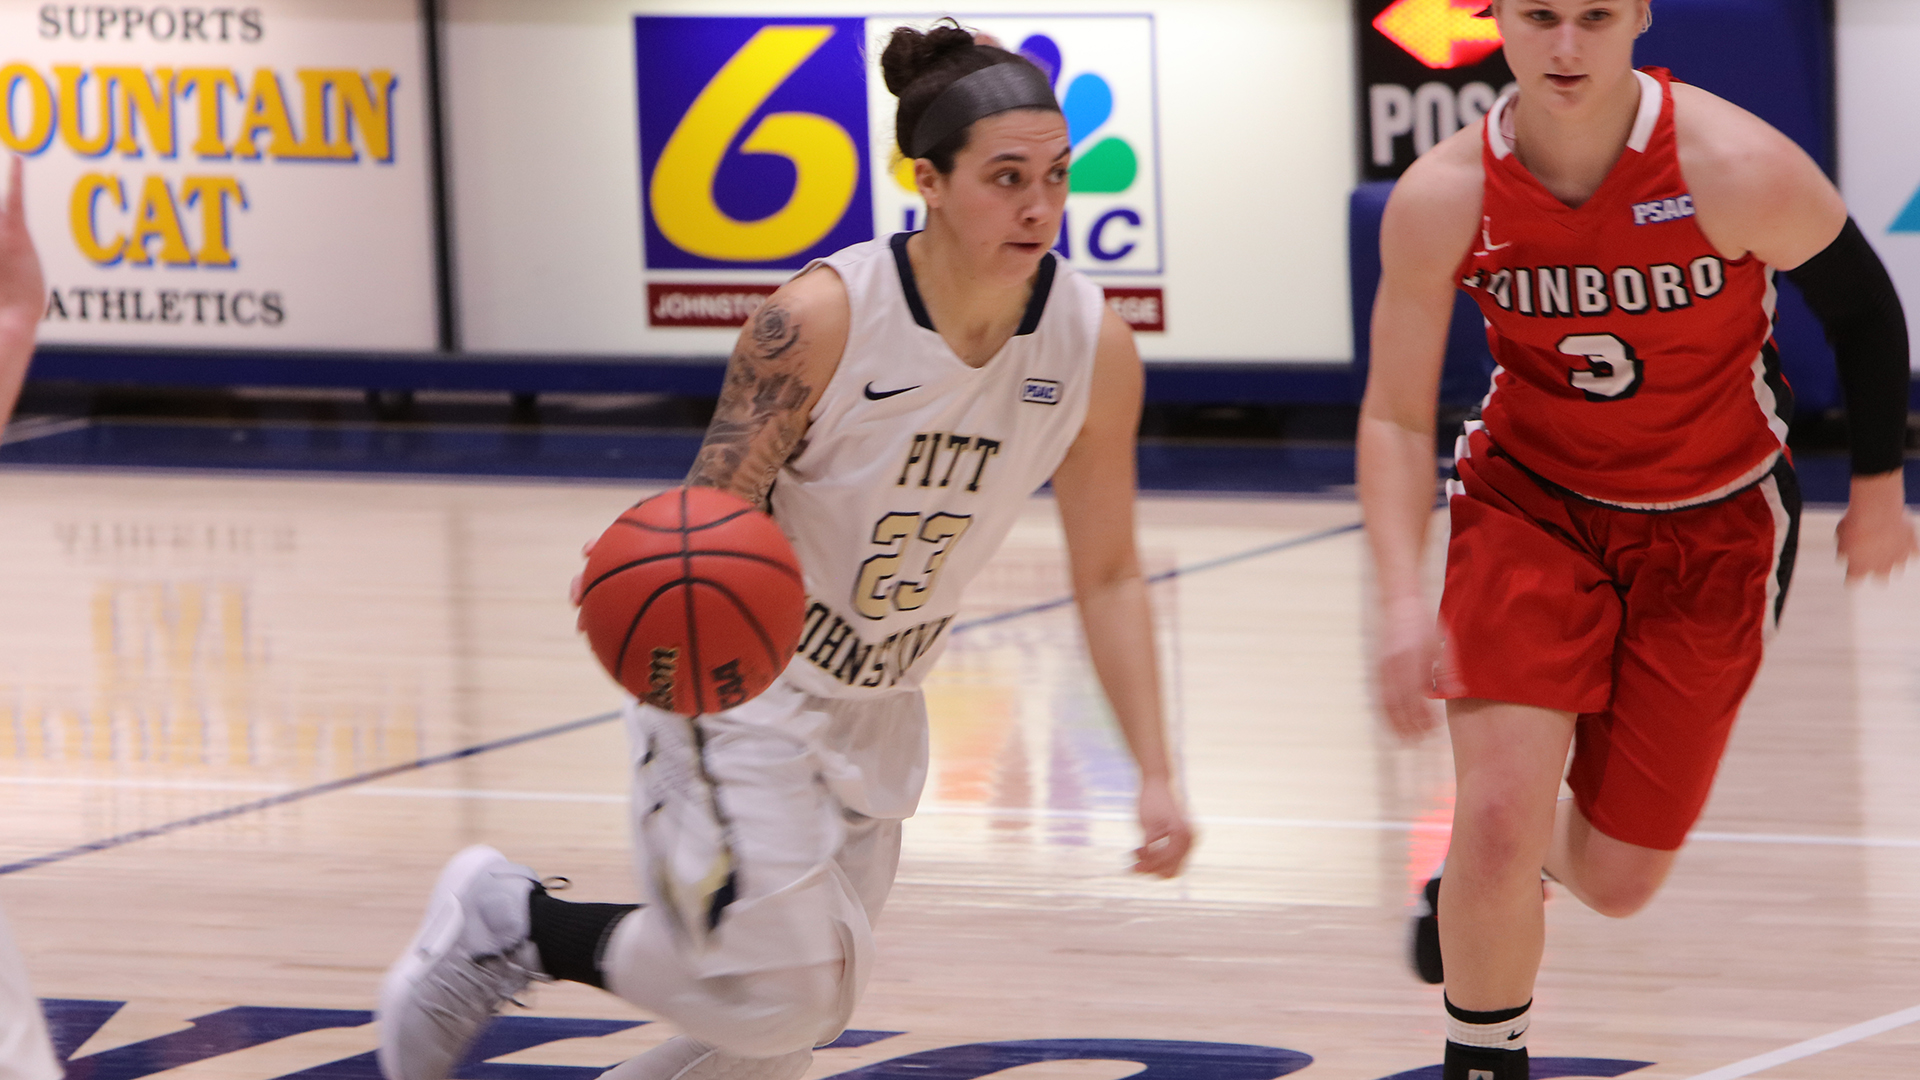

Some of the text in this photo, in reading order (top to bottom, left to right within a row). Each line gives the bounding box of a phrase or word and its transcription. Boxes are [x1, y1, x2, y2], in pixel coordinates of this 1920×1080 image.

[39, 6, 264, 42] SUPPORTS
[0, 62, 398, 164] OUNTAIN
[649, 25, 859, 262] 6
[1368, 81, 1520, 167] POS
[69, 172, 249, 270] CAT
[1632, 194, 1694, 226] PSAC
[46, 288, 284, 326] ATHLETICS
[653, 292, 768, 320] JOHNSTO
[1556, 332, 1644, 402] 3
[897, 432, 1001, 493] PITT
[853, 511, 973, 621] 23
